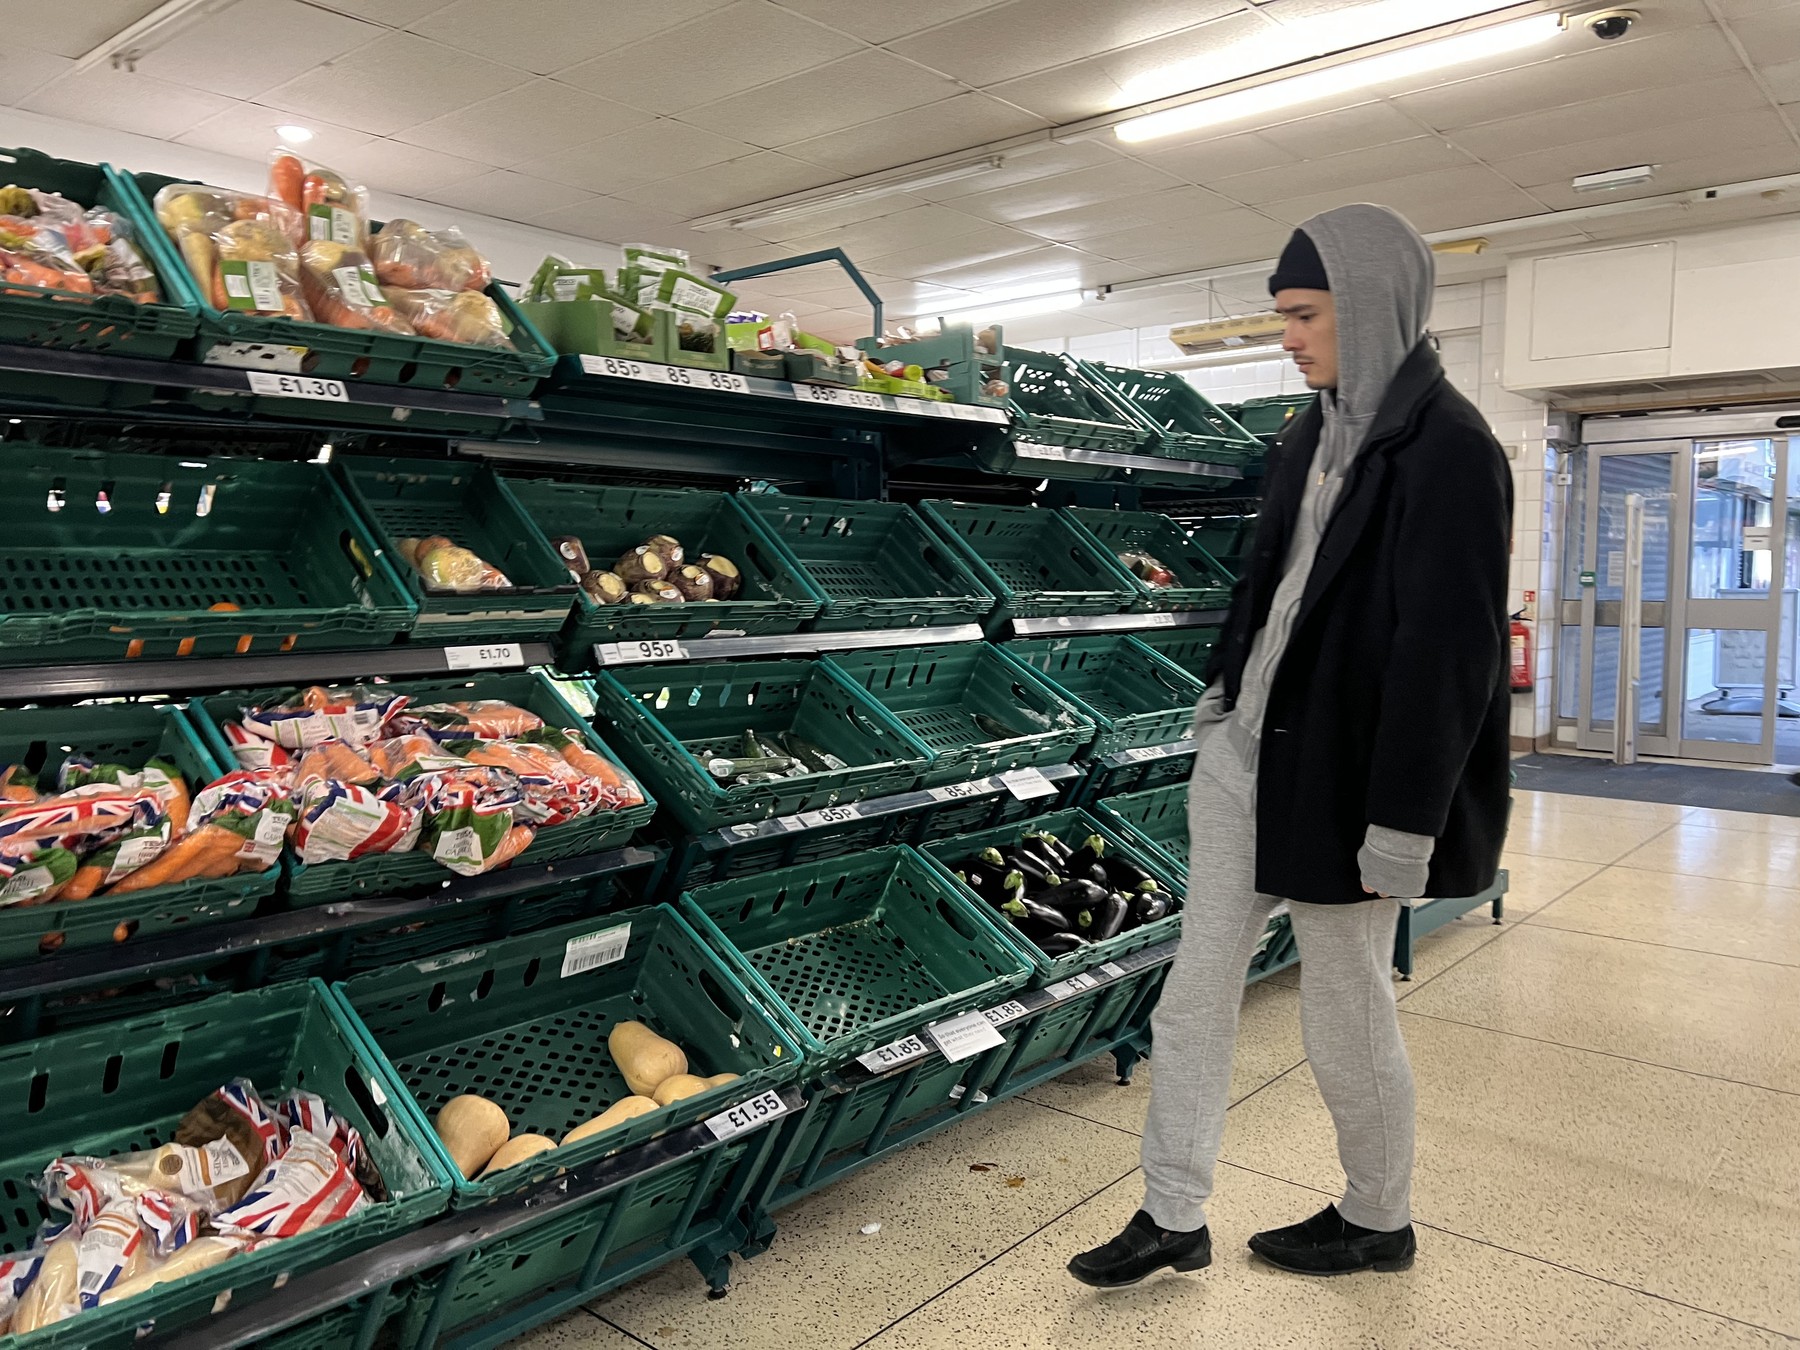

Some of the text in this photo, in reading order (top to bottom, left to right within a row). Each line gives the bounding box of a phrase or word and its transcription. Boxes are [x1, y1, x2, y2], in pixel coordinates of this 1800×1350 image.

[605, 358, 640, 377] 85p
[279, 377, 342, 397] £1.30
[710, 372, 741, 391] 85p
[478, 648, 512, 660] £1.70
[638, 641, 675, 659] 95p
[821, 806, 852, 823] 85p
[1066, 976, 1089, 991] £1
[984, 1001, 1024, 1023] £1.85
[876, 1038, 922, 1063] £1.85
[727, 1093, 780, 1128] £1.55
